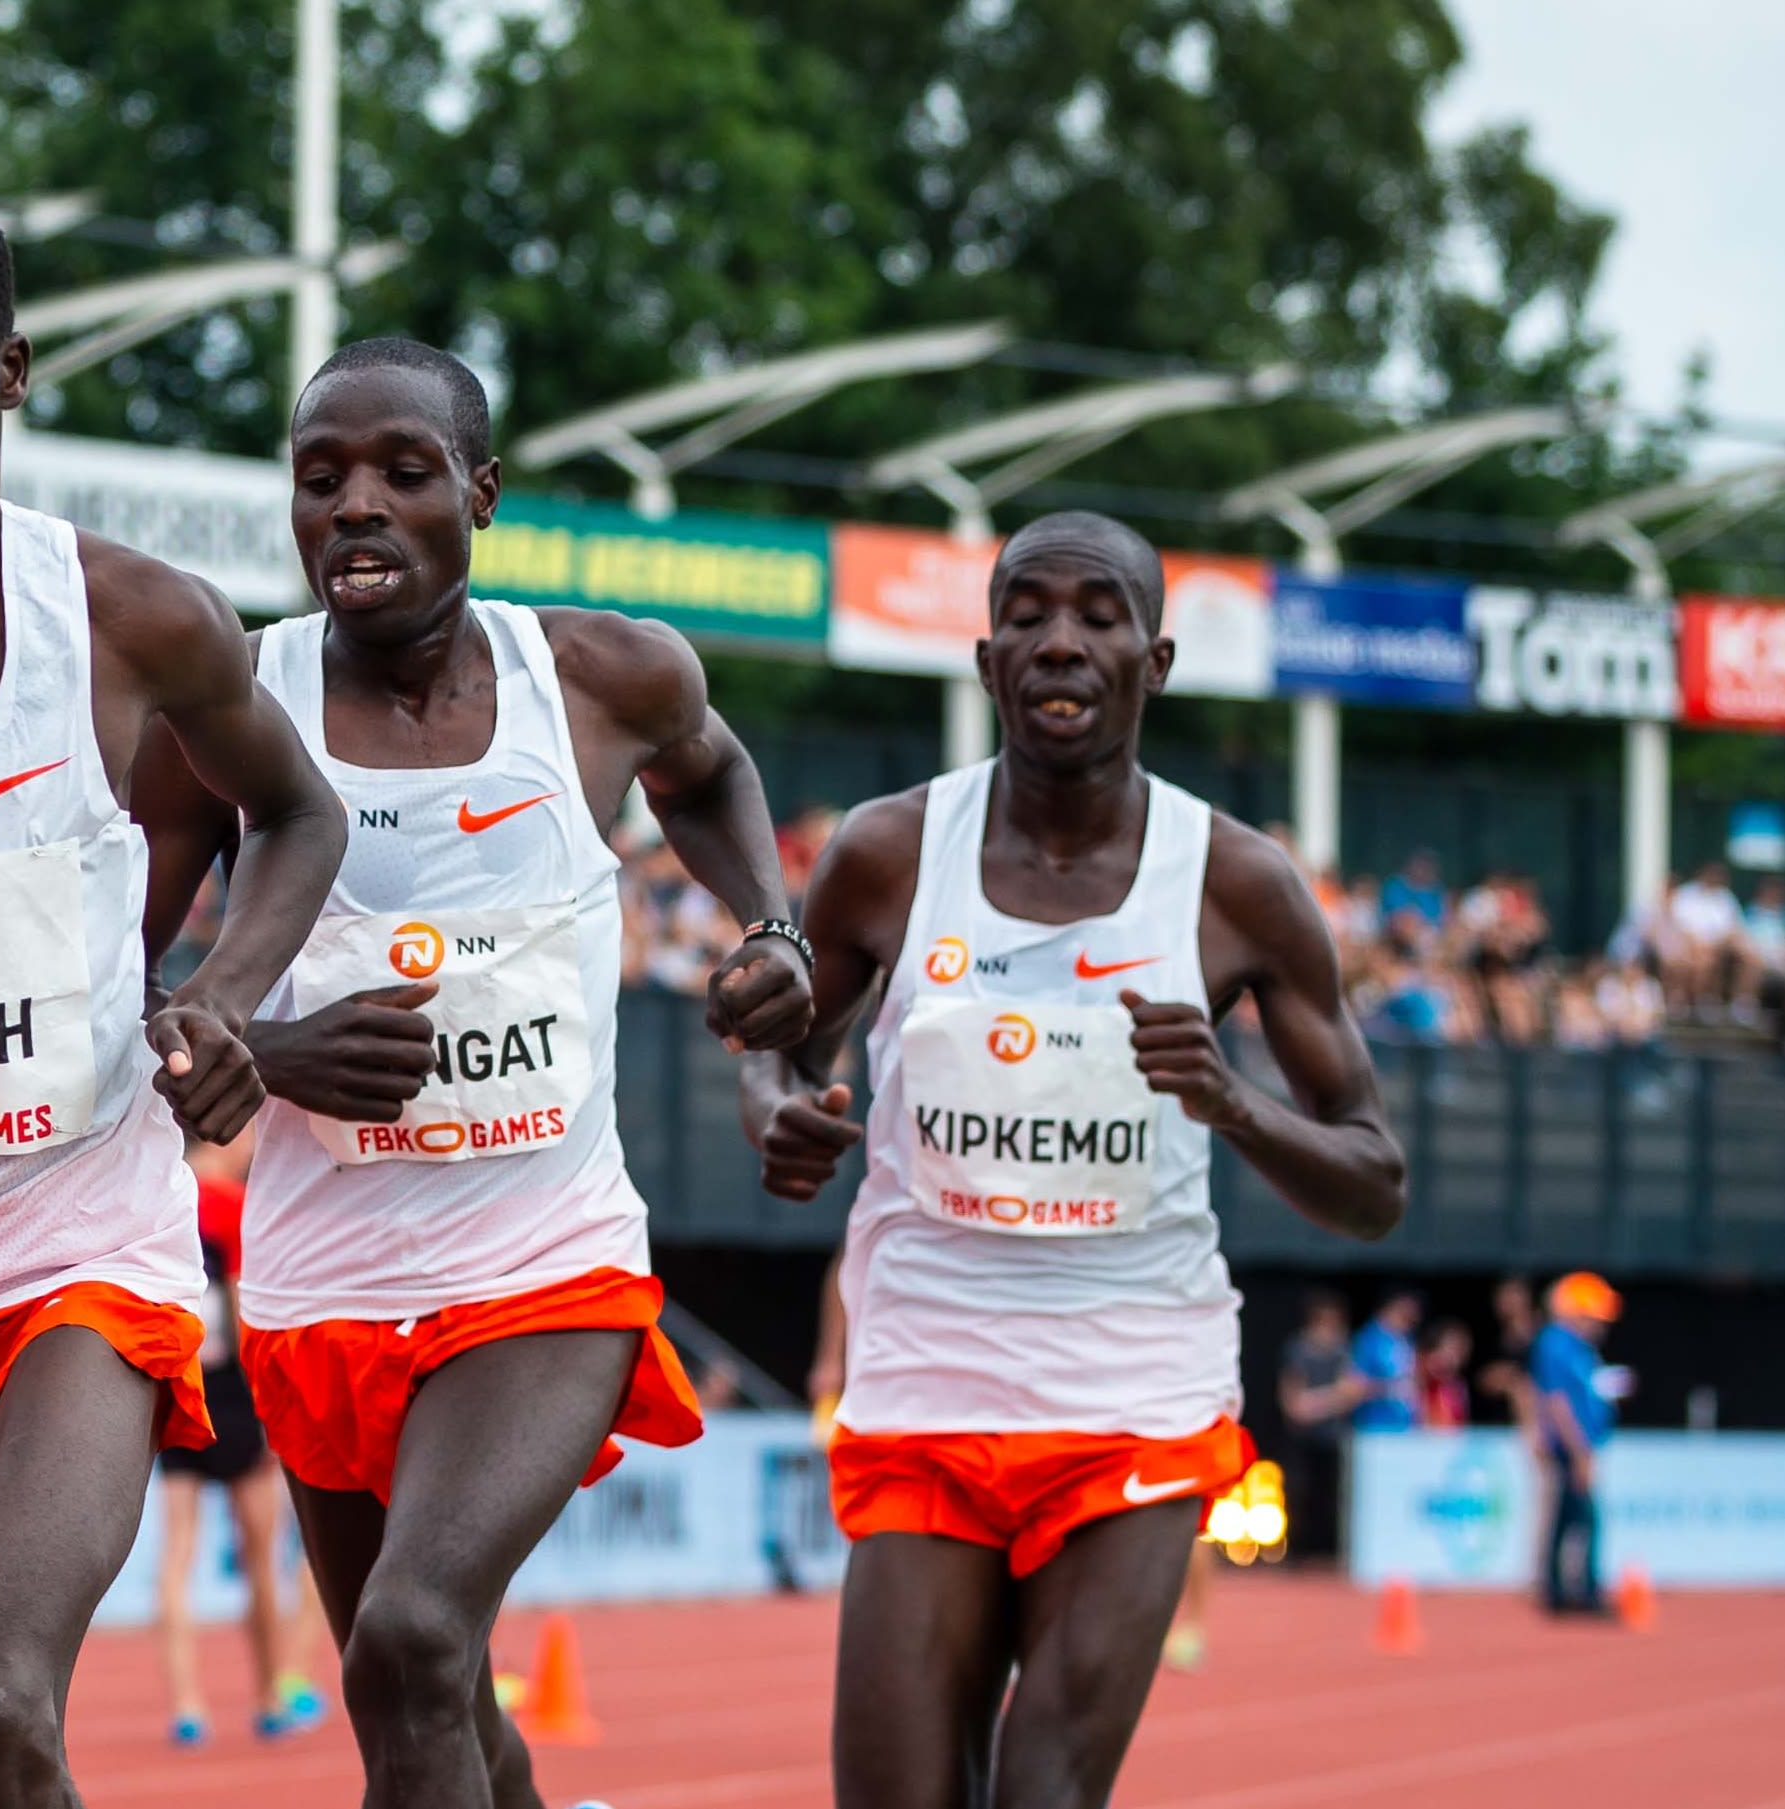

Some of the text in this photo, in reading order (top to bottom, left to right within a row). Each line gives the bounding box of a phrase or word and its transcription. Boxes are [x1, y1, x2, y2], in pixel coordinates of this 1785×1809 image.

[1464, 588, 1676, 714] Tom
[359, 809, 399, 828] NN
[456, 936, 496, 955] NN
[974, 957, 1009, 976] NN
[1046, 1031, 1083, 1049] NN
[470, 1107, 565, 1149] GAMES
[916, 1105, 1148, 1164] KIPKEMOI
[1032, 1199, 1117, 1226] GAMES
